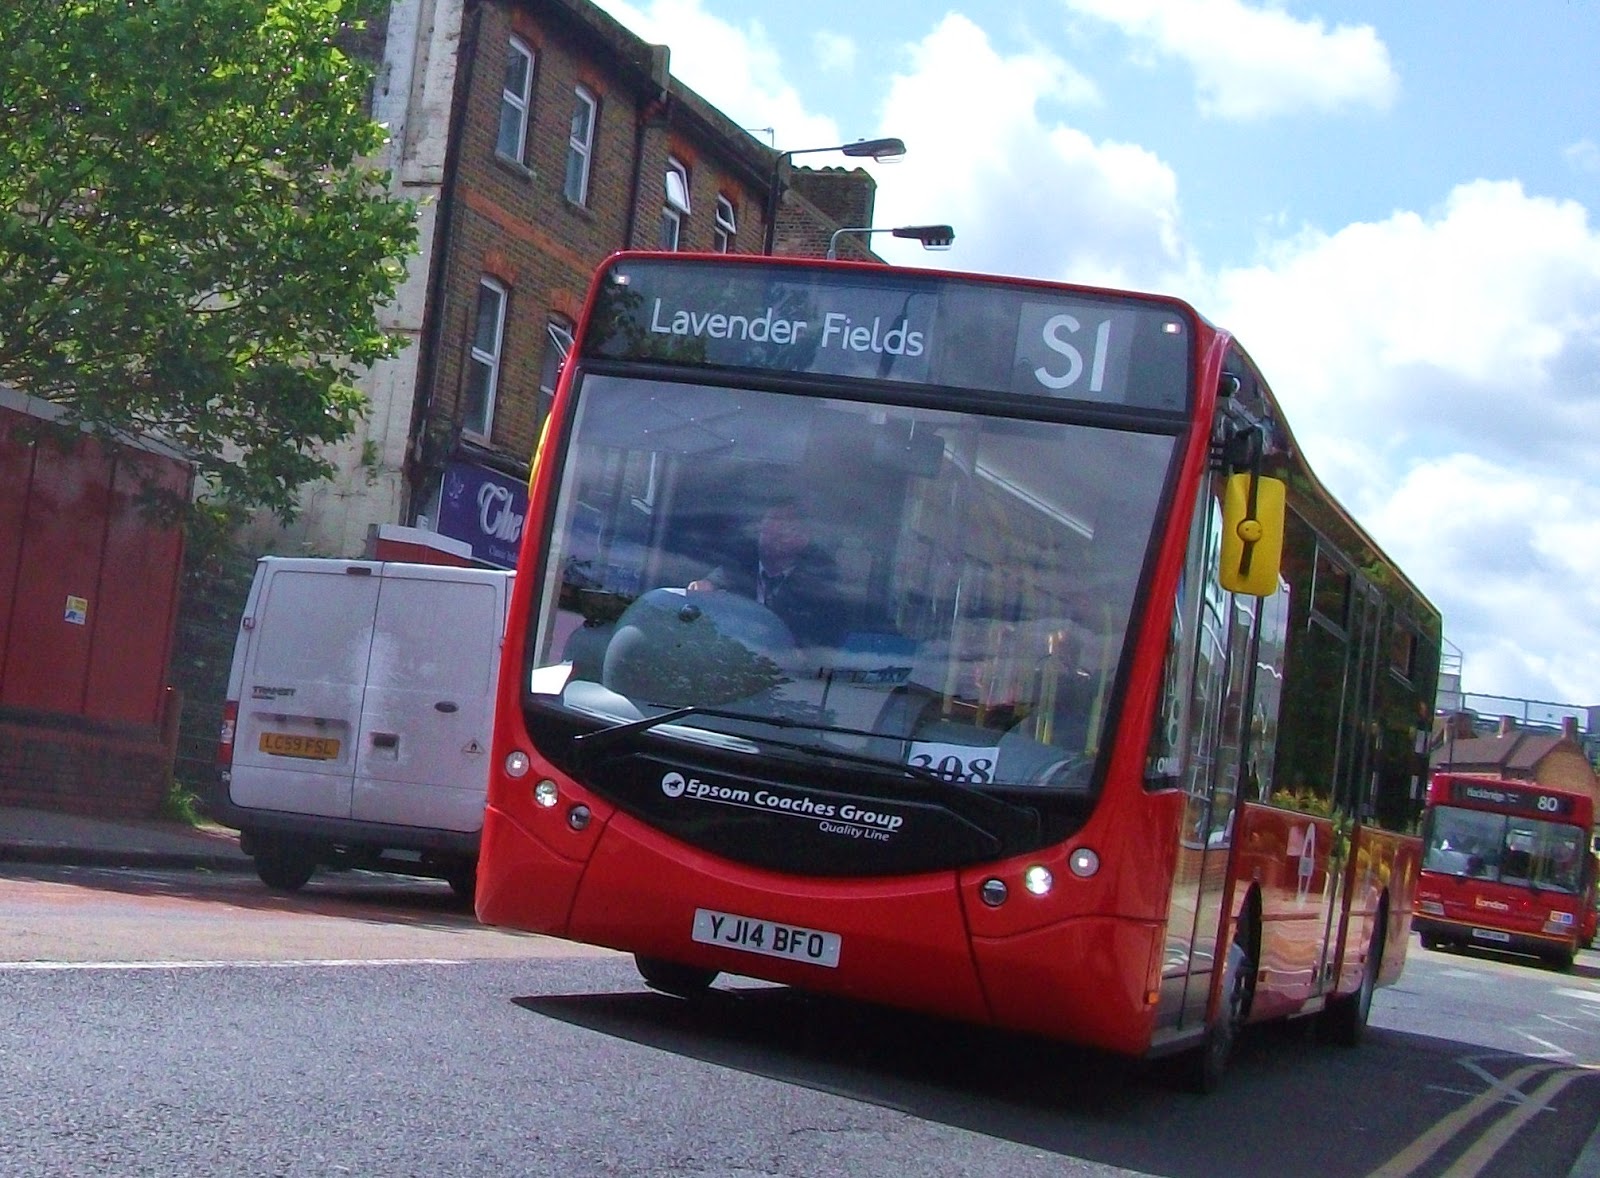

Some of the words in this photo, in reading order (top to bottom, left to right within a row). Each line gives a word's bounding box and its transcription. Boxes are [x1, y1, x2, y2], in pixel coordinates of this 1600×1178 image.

[650, 297, 808, 346] Lavender
[821, 312, 925, 357] Fields
[1034, 313, 1112, 393] S1
[305, 739, 333, 755] FSL
[685, 779, 750, 803] Epsom
[753, 790, 836, 818] Coaches
[839, 804, 904, 830] Group
[1537, 795, 1558, 812] 80
[818, 820, 864, 839] Quality
[863, 828, 891, 843] Line
[710, 914, 765, 947] YJ14
[772, 927, 825, 959] BFO
